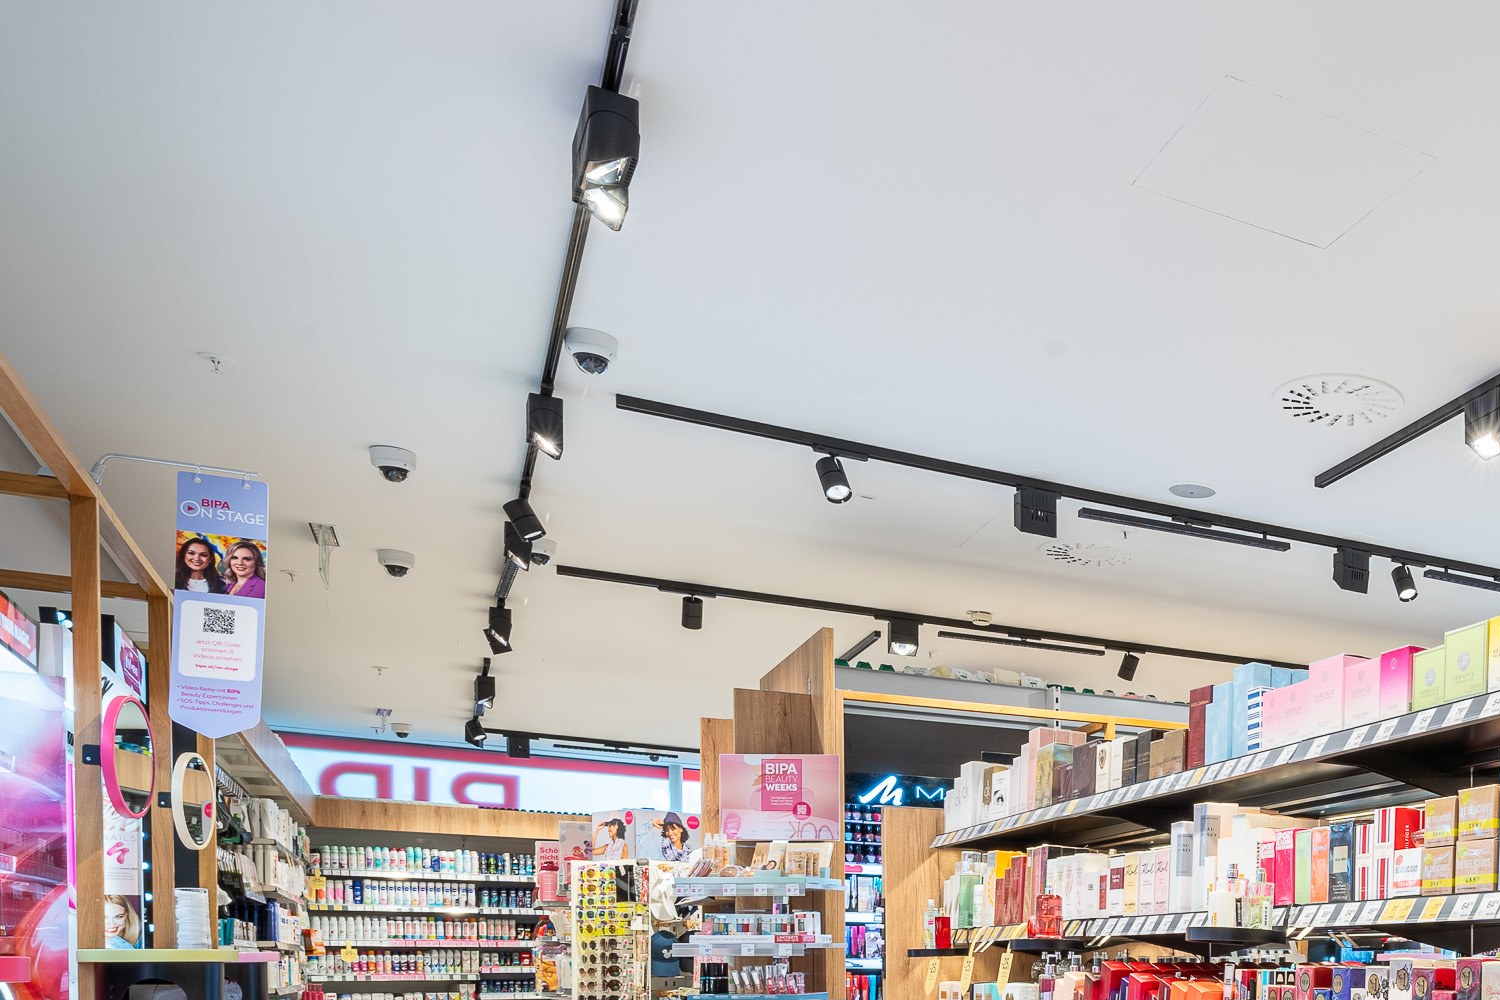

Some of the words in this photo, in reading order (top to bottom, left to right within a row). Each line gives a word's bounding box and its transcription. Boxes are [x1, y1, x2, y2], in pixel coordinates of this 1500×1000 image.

[201, 499, 230, 510] BIPA
[216, 510, 265, 526] STAGE
[765, 763, 797, 774] BIPA
[765, 783, 797, 791] WEEKS
[1466, 876, 1480, 884] DKNY
